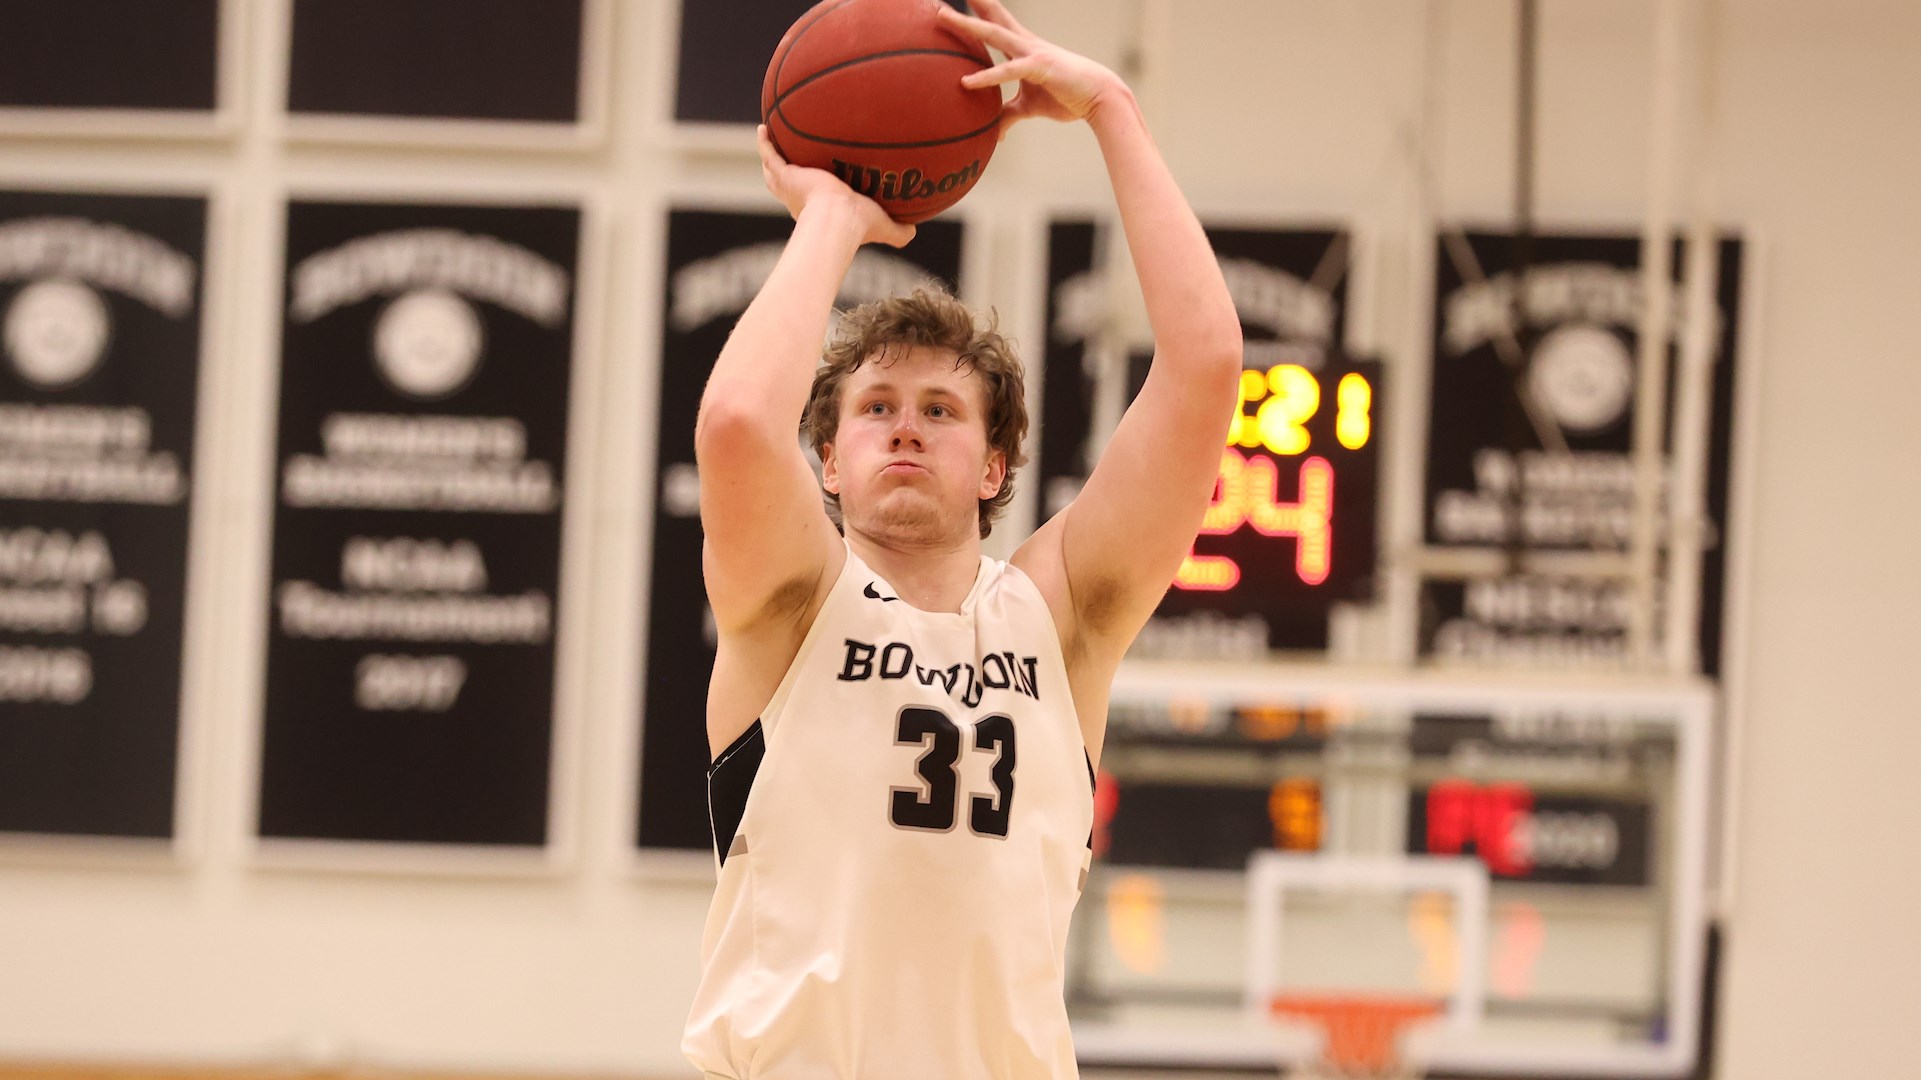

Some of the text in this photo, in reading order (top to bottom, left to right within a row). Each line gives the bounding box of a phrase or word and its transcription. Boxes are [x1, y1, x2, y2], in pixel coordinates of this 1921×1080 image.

[832, 157, 981, 200] Wilson
[342, 536, 487, 592] NCAA
[887, 703, 1018, 841] 33
